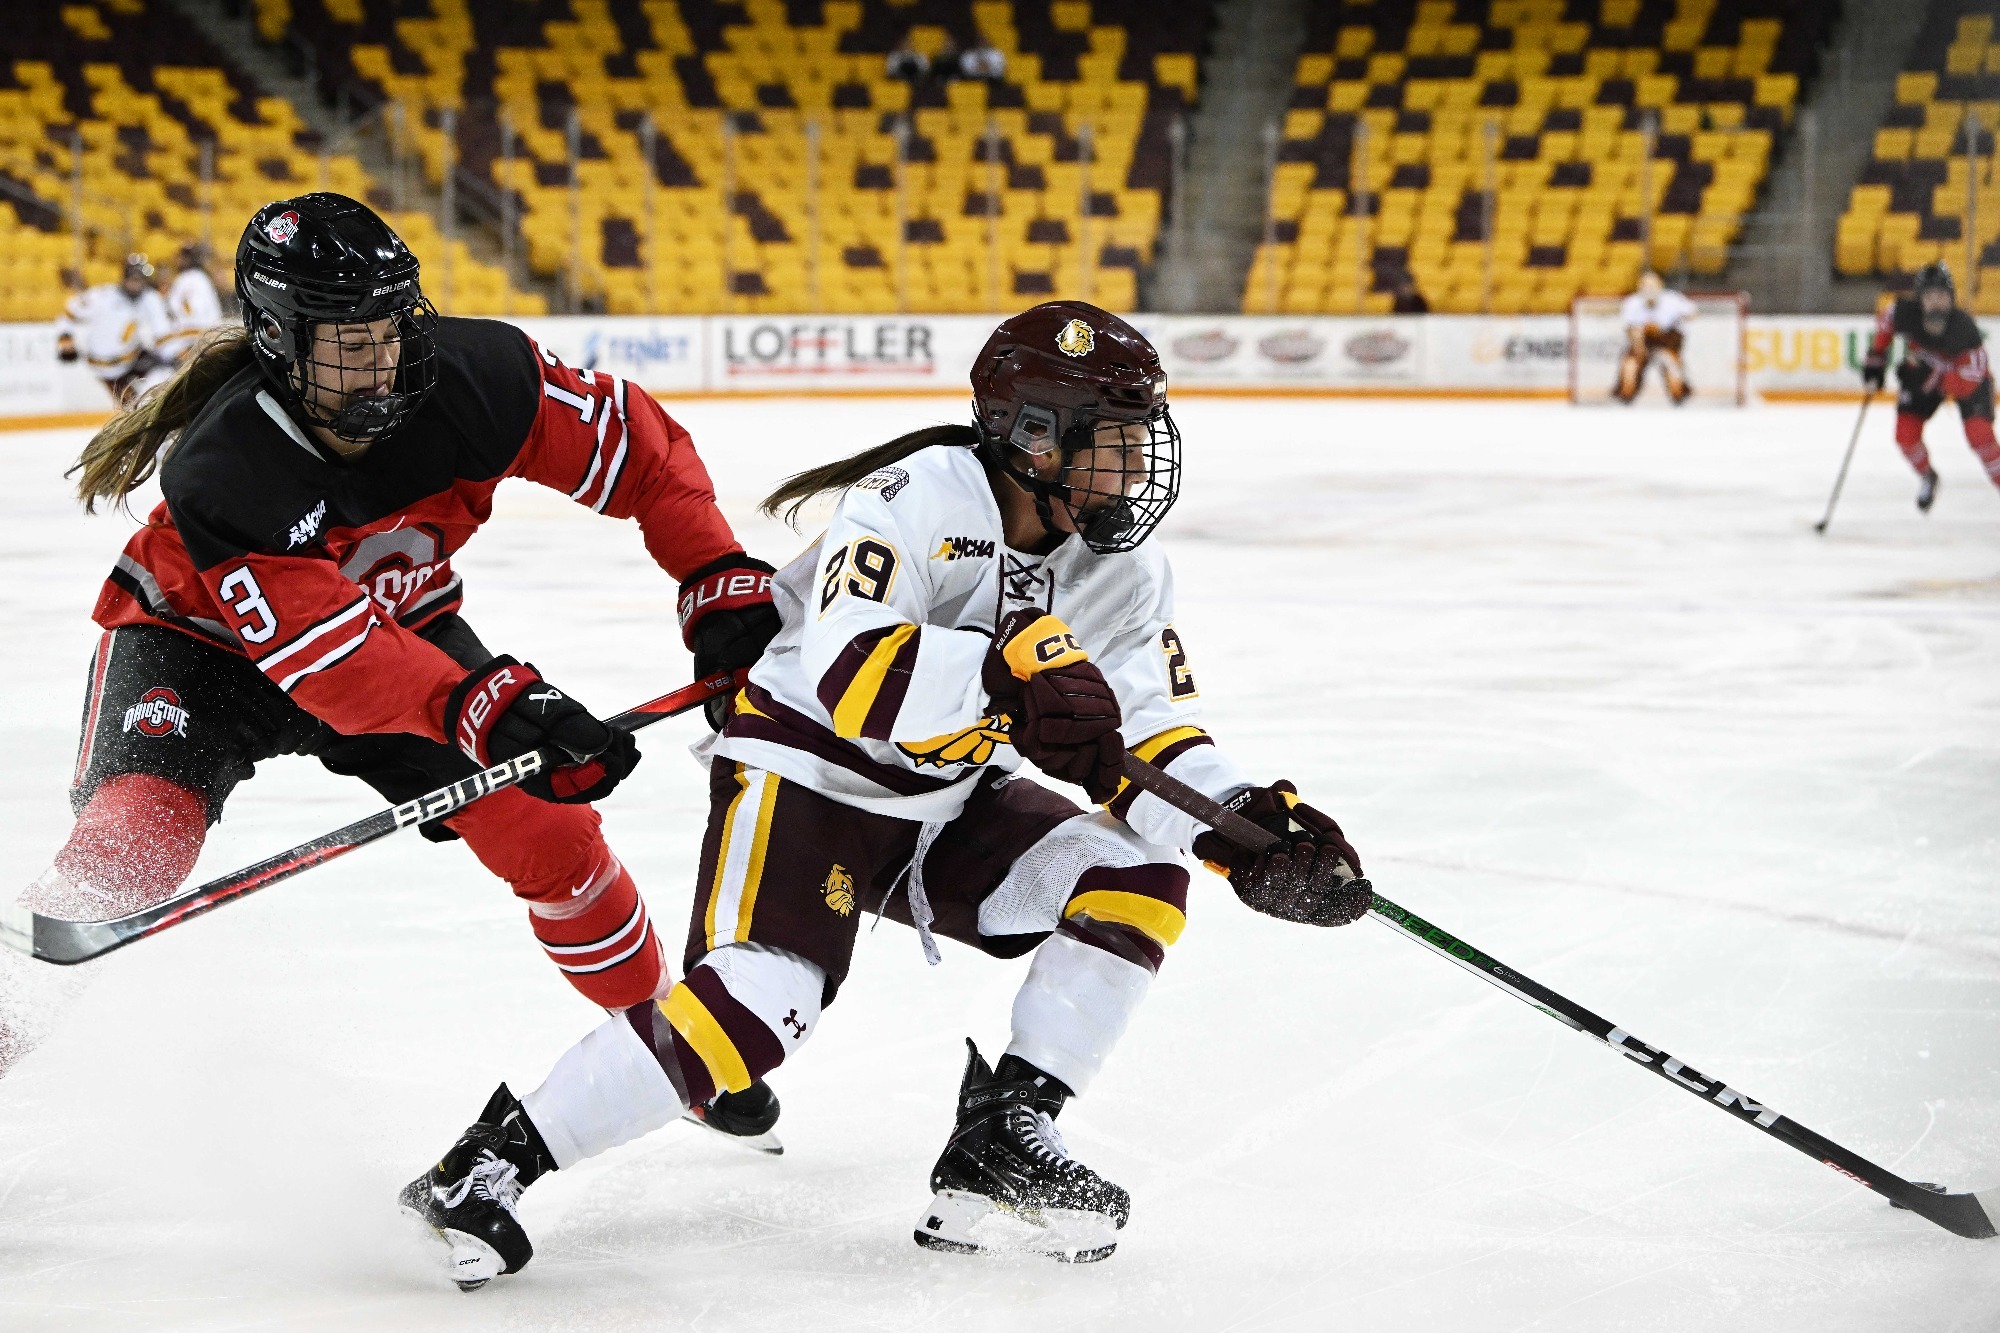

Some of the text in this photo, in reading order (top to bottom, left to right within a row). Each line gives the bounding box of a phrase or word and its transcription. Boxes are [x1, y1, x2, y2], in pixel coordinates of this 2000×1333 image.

[723, 324, 933, 363] LOFFLER
[679, 575, 772, 629] AUER
[818, 535, 901, 621] 29
[995, 616, 1017, 651] BULLDOGS
[459, 668, 518, 768] UER
[392, 748, 542, 828] BAUER
[1606, 1026, 1781, 1128] CCM
[458, 1257, 481, 1266] CCM
